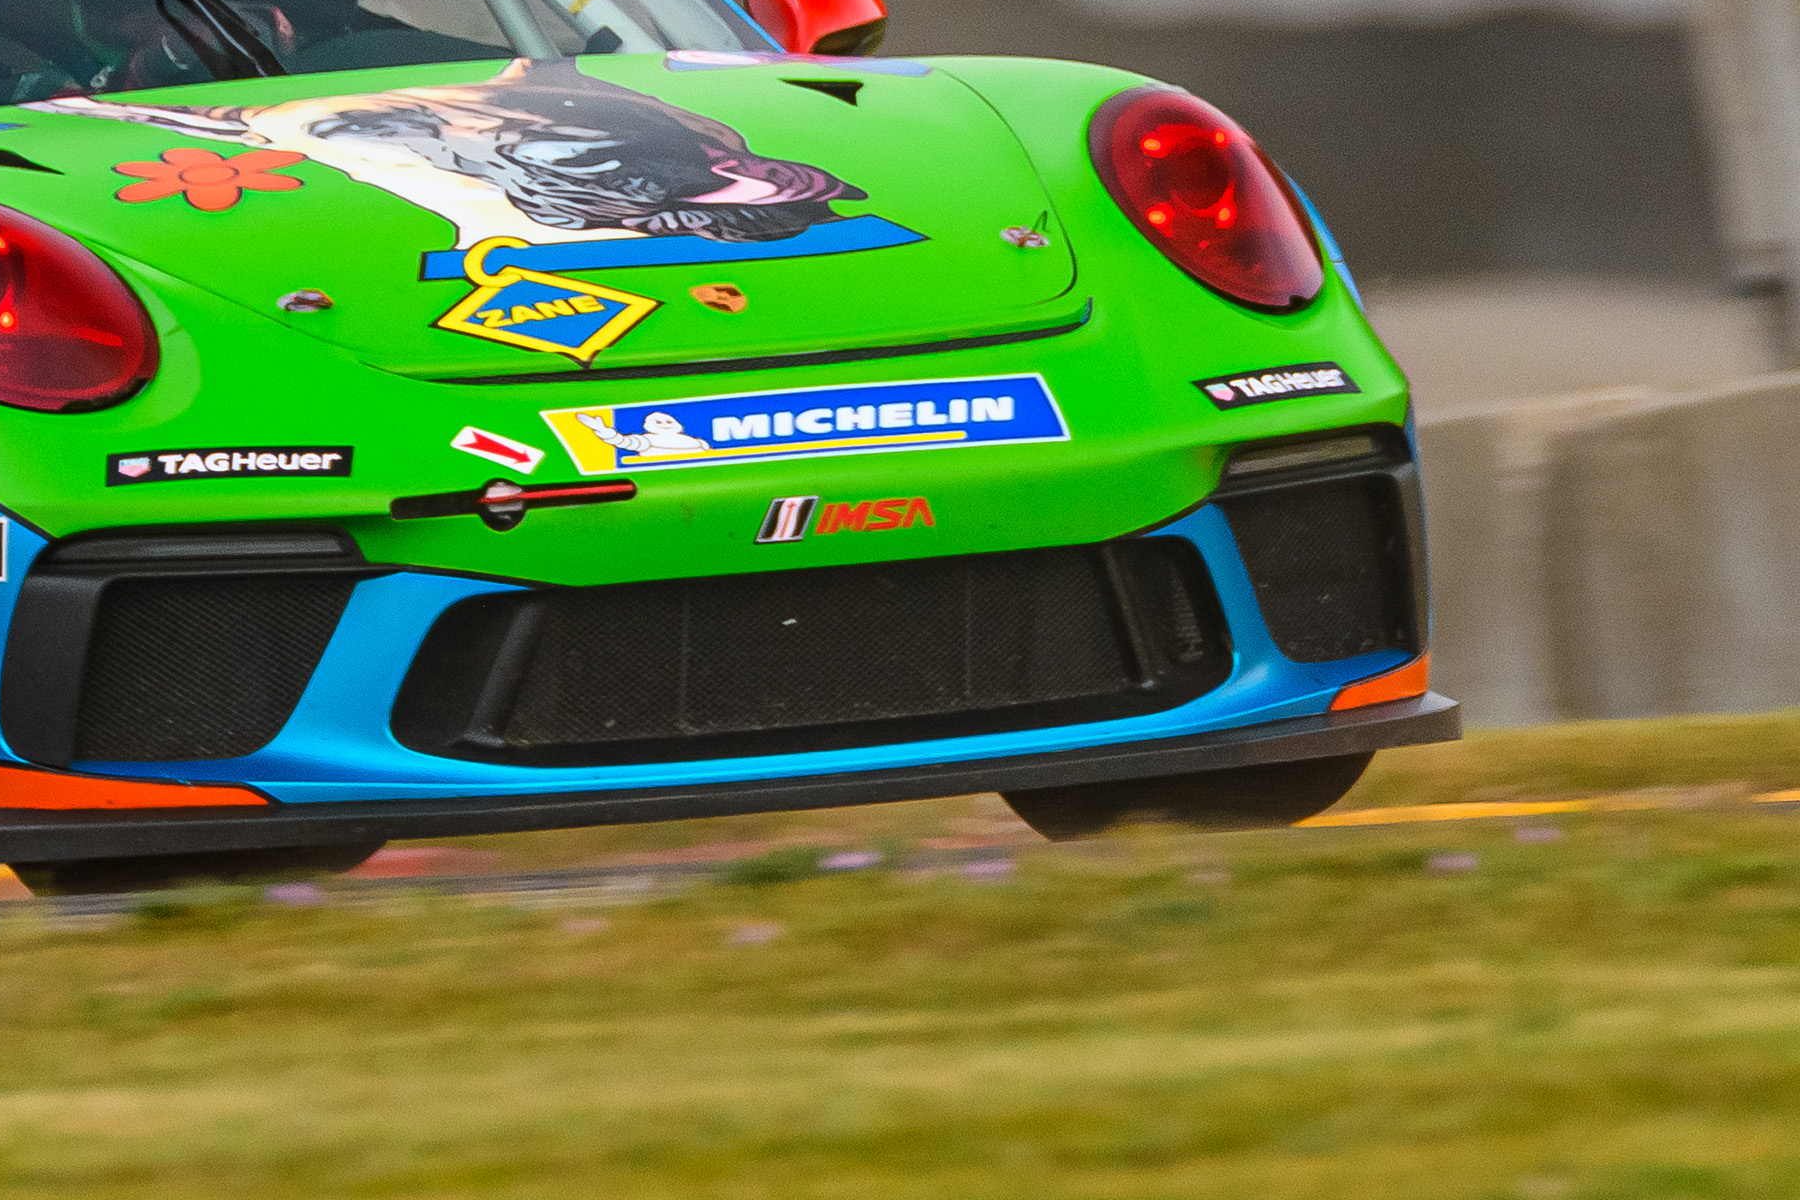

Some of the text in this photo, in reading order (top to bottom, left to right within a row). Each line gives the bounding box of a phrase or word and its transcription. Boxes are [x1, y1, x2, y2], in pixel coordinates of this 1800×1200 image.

[475, 294, 606, 328] ZANE
[711, 396, 1016, 442] MICHELIN
[815, 497, 936, 535] IMSA
